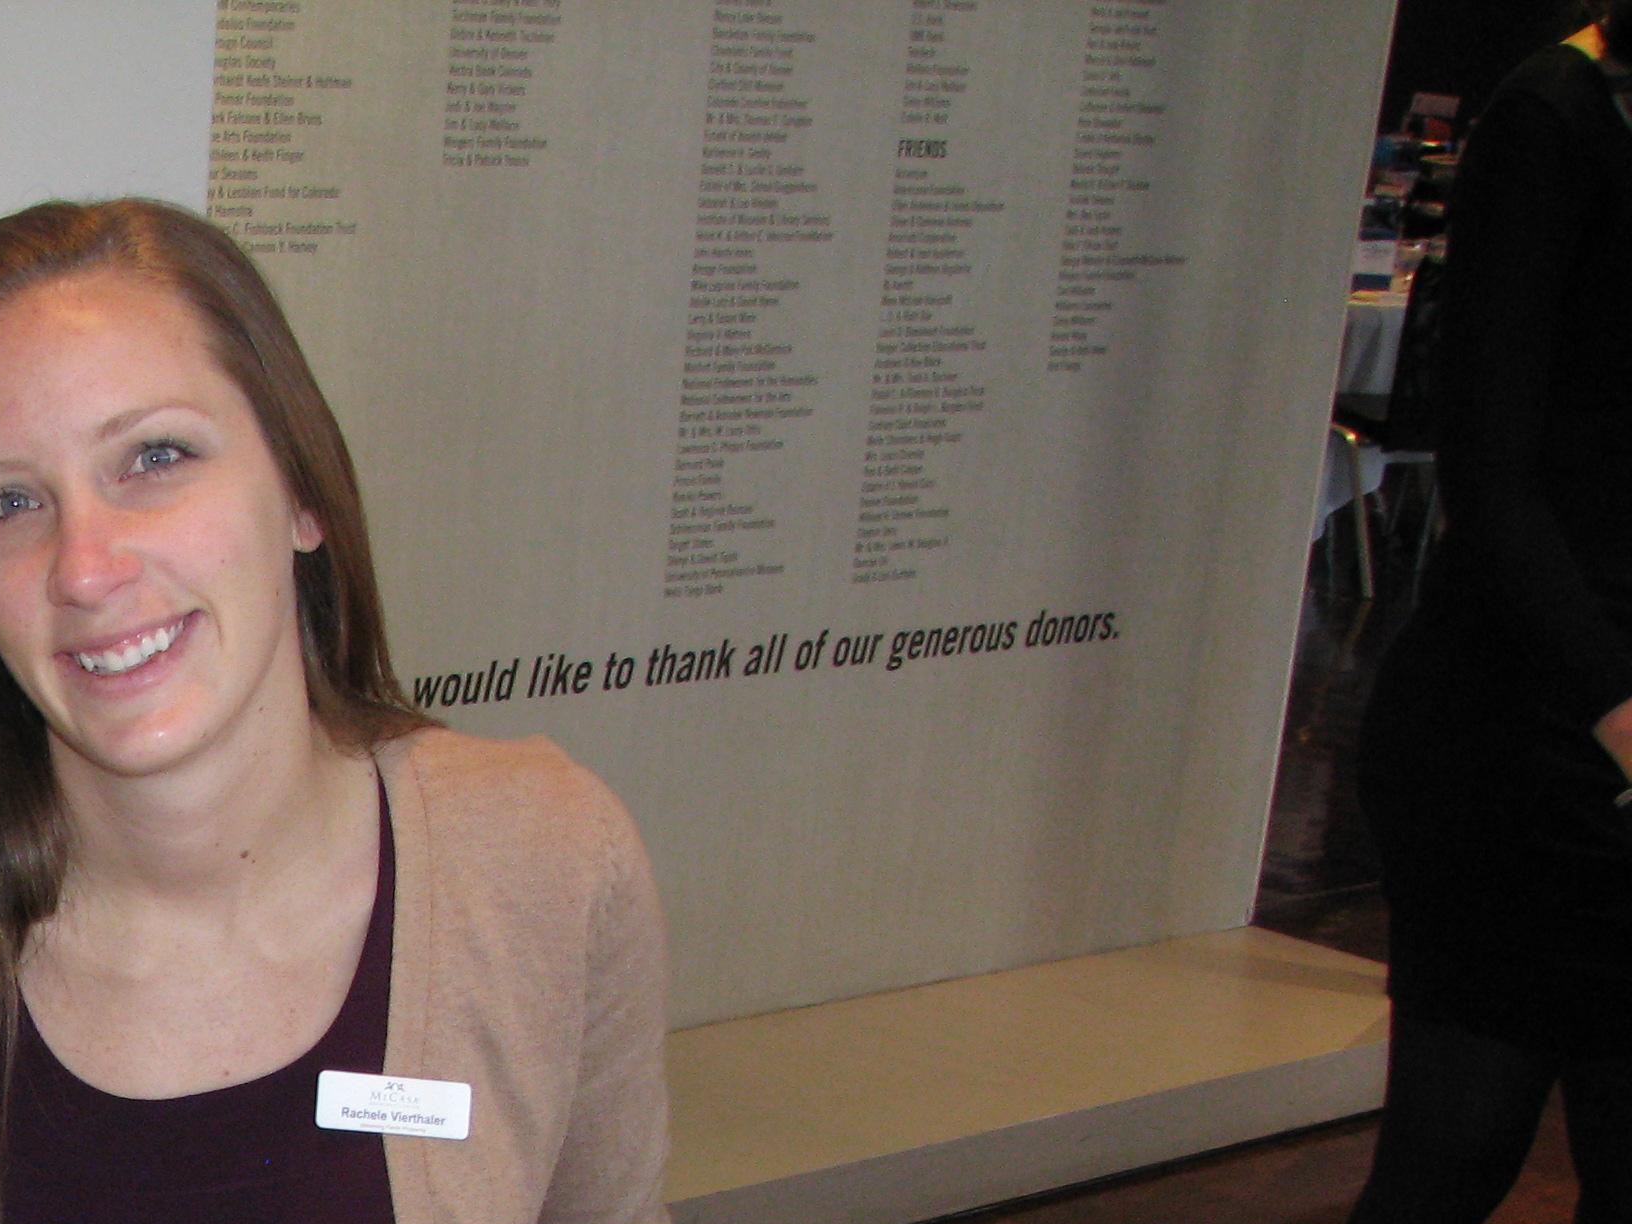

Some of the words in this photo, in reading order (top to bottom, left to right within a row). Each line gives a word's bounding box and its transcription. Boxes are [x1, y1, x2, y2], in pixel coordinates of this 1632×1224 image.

[413, 657, 520, 709] would
[527, 653, 593, 699] like
[602, 652, 636, 691] to
[645, 638, 737, 687] thank
[743, 633, 789, 677] all
[794, 629, 830, 672] of
[833, 634, 884, 668] our
[886, 621, 1018, 672] generous
[1025, 609, 1120, 647] donors.
[341, 1106, 387, 1122] Rachele
[390, 1111, 446, 1126] Vierthaler
